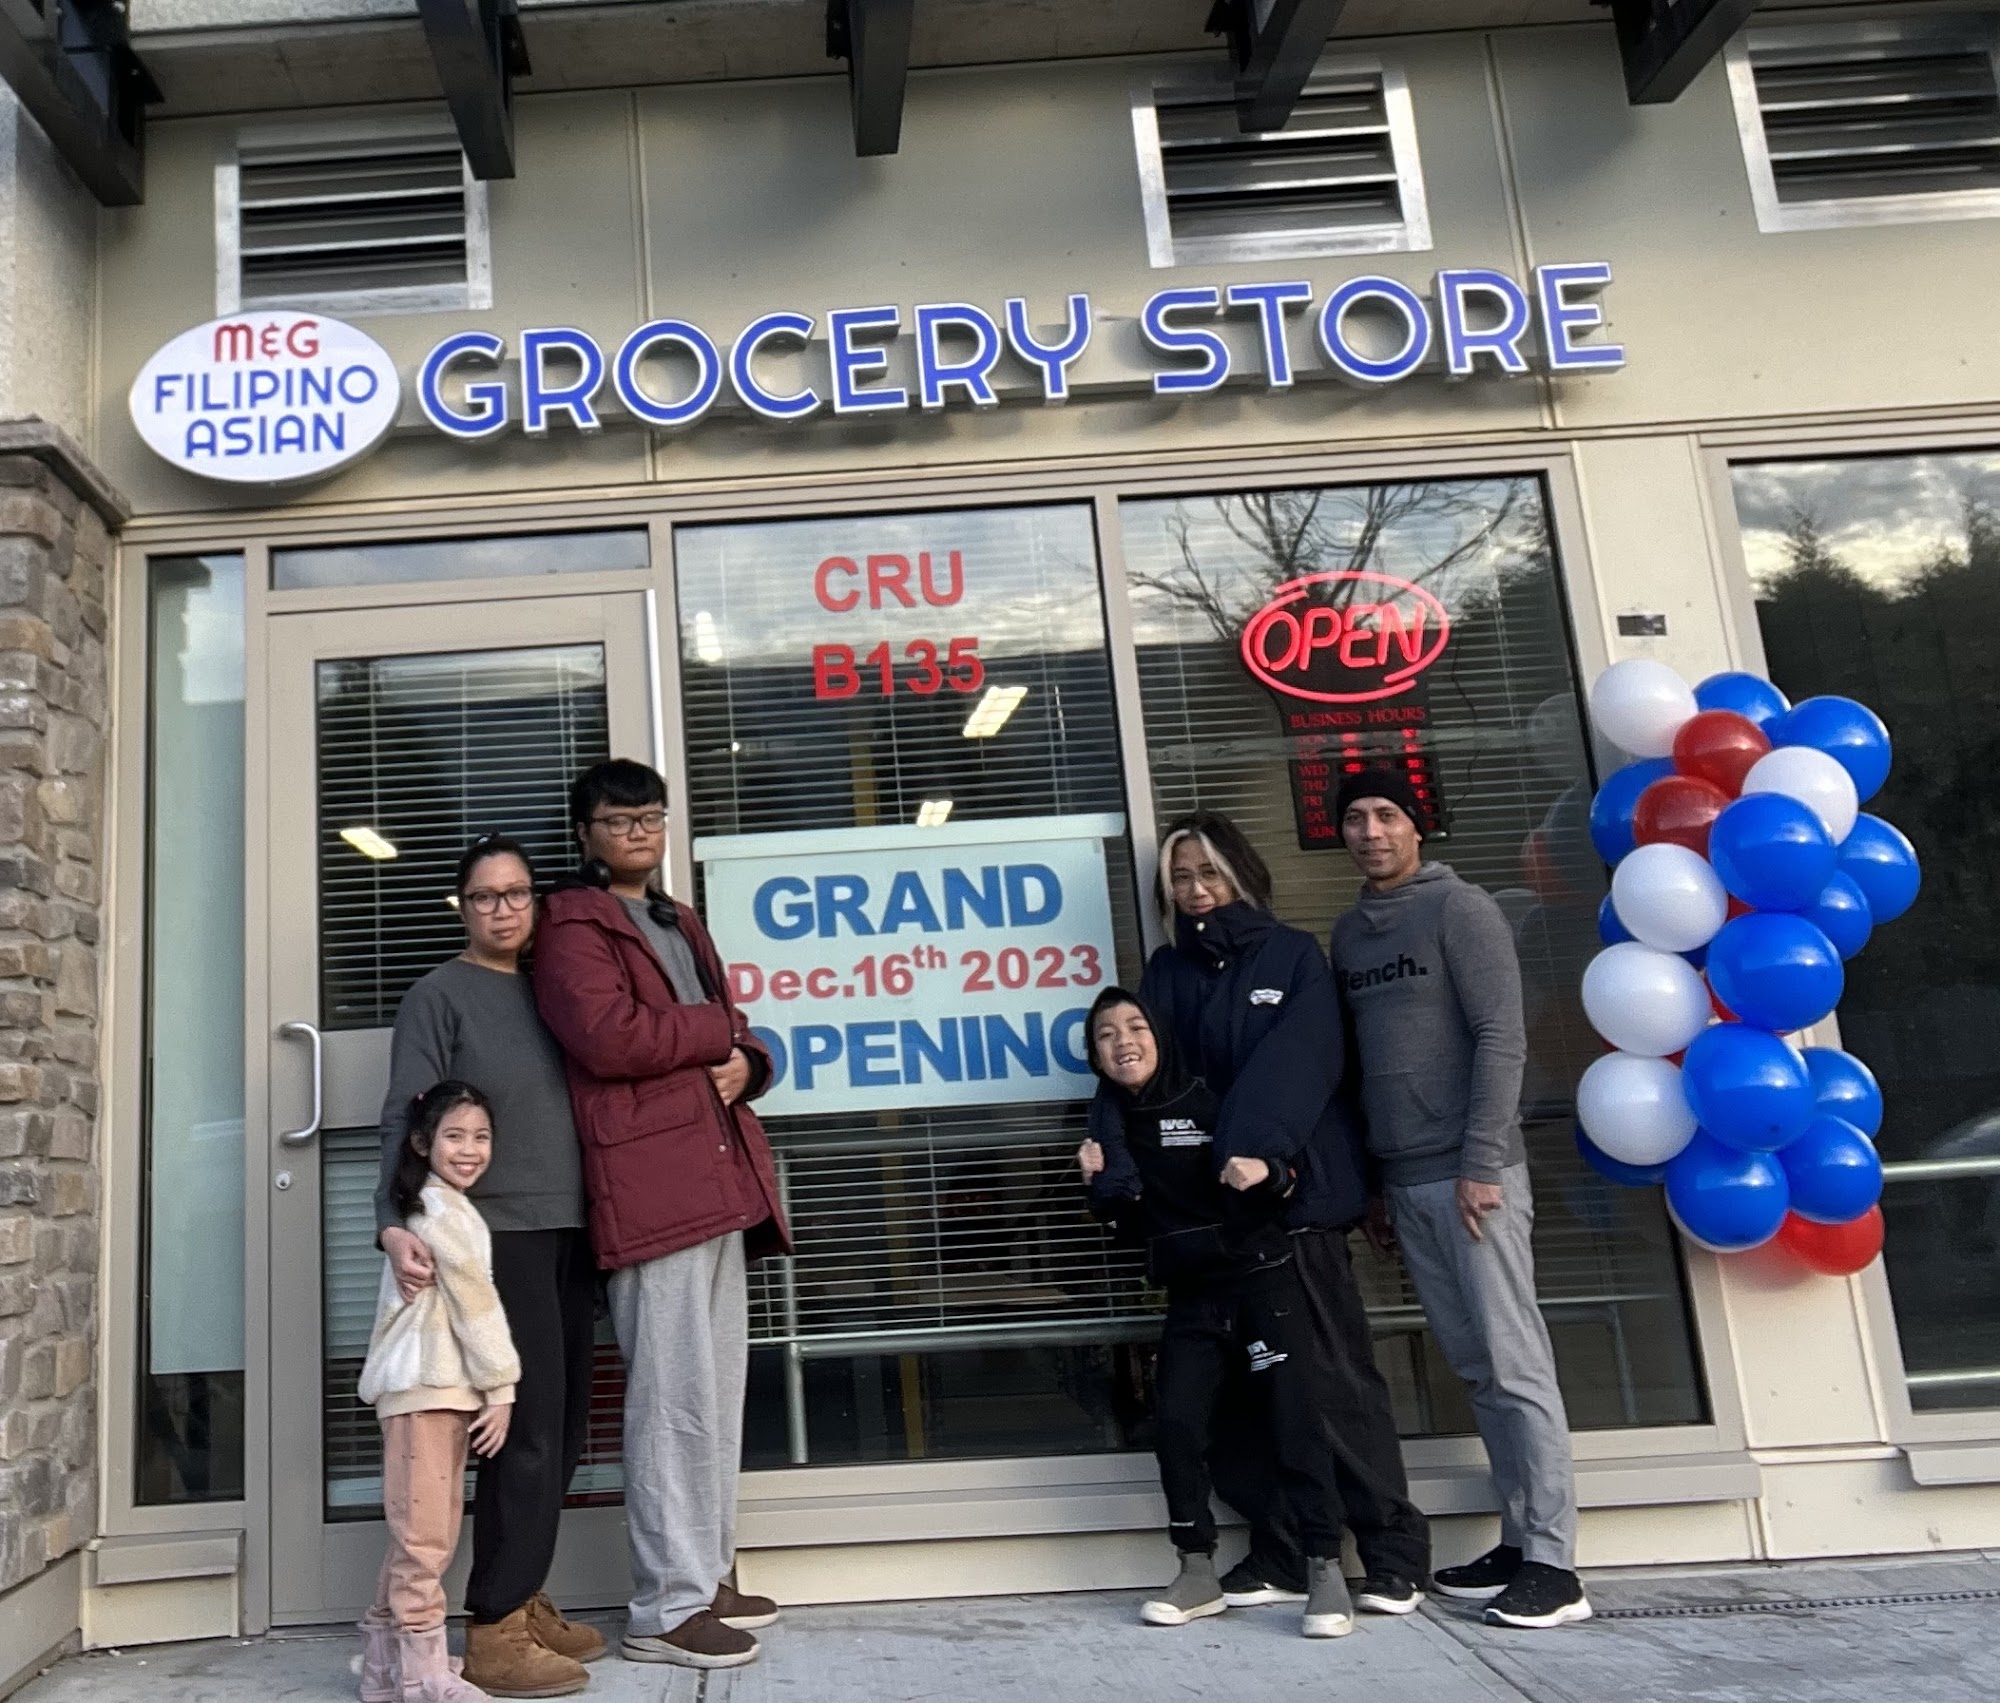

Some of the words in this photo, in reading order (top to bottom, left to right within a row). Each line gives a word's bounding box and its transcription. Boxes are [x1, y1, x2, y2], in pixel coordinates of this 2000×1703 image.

[214, 319, 320, 362] M&G
[416, 293, 1092, 439] GROCERY
[1139, 262, 1626, 393] STORE
[155, 364, 378, 413] FILIPINO
[185, 412, 345, 459] ASIAN
[814, 550, 964, 613] CRU
[1254, 602, 1426, 671] OPEN
[812, 637, 985, 700] B135
[1290, 710, 1362, 729] BUSINESS
[1366, 705, 1426, 724] HOURS
[753, 863, 1063, 941] GRAND
[728, 944, 948, 1005] Dec.16th
[960, 944, 1102, 994] 2023
